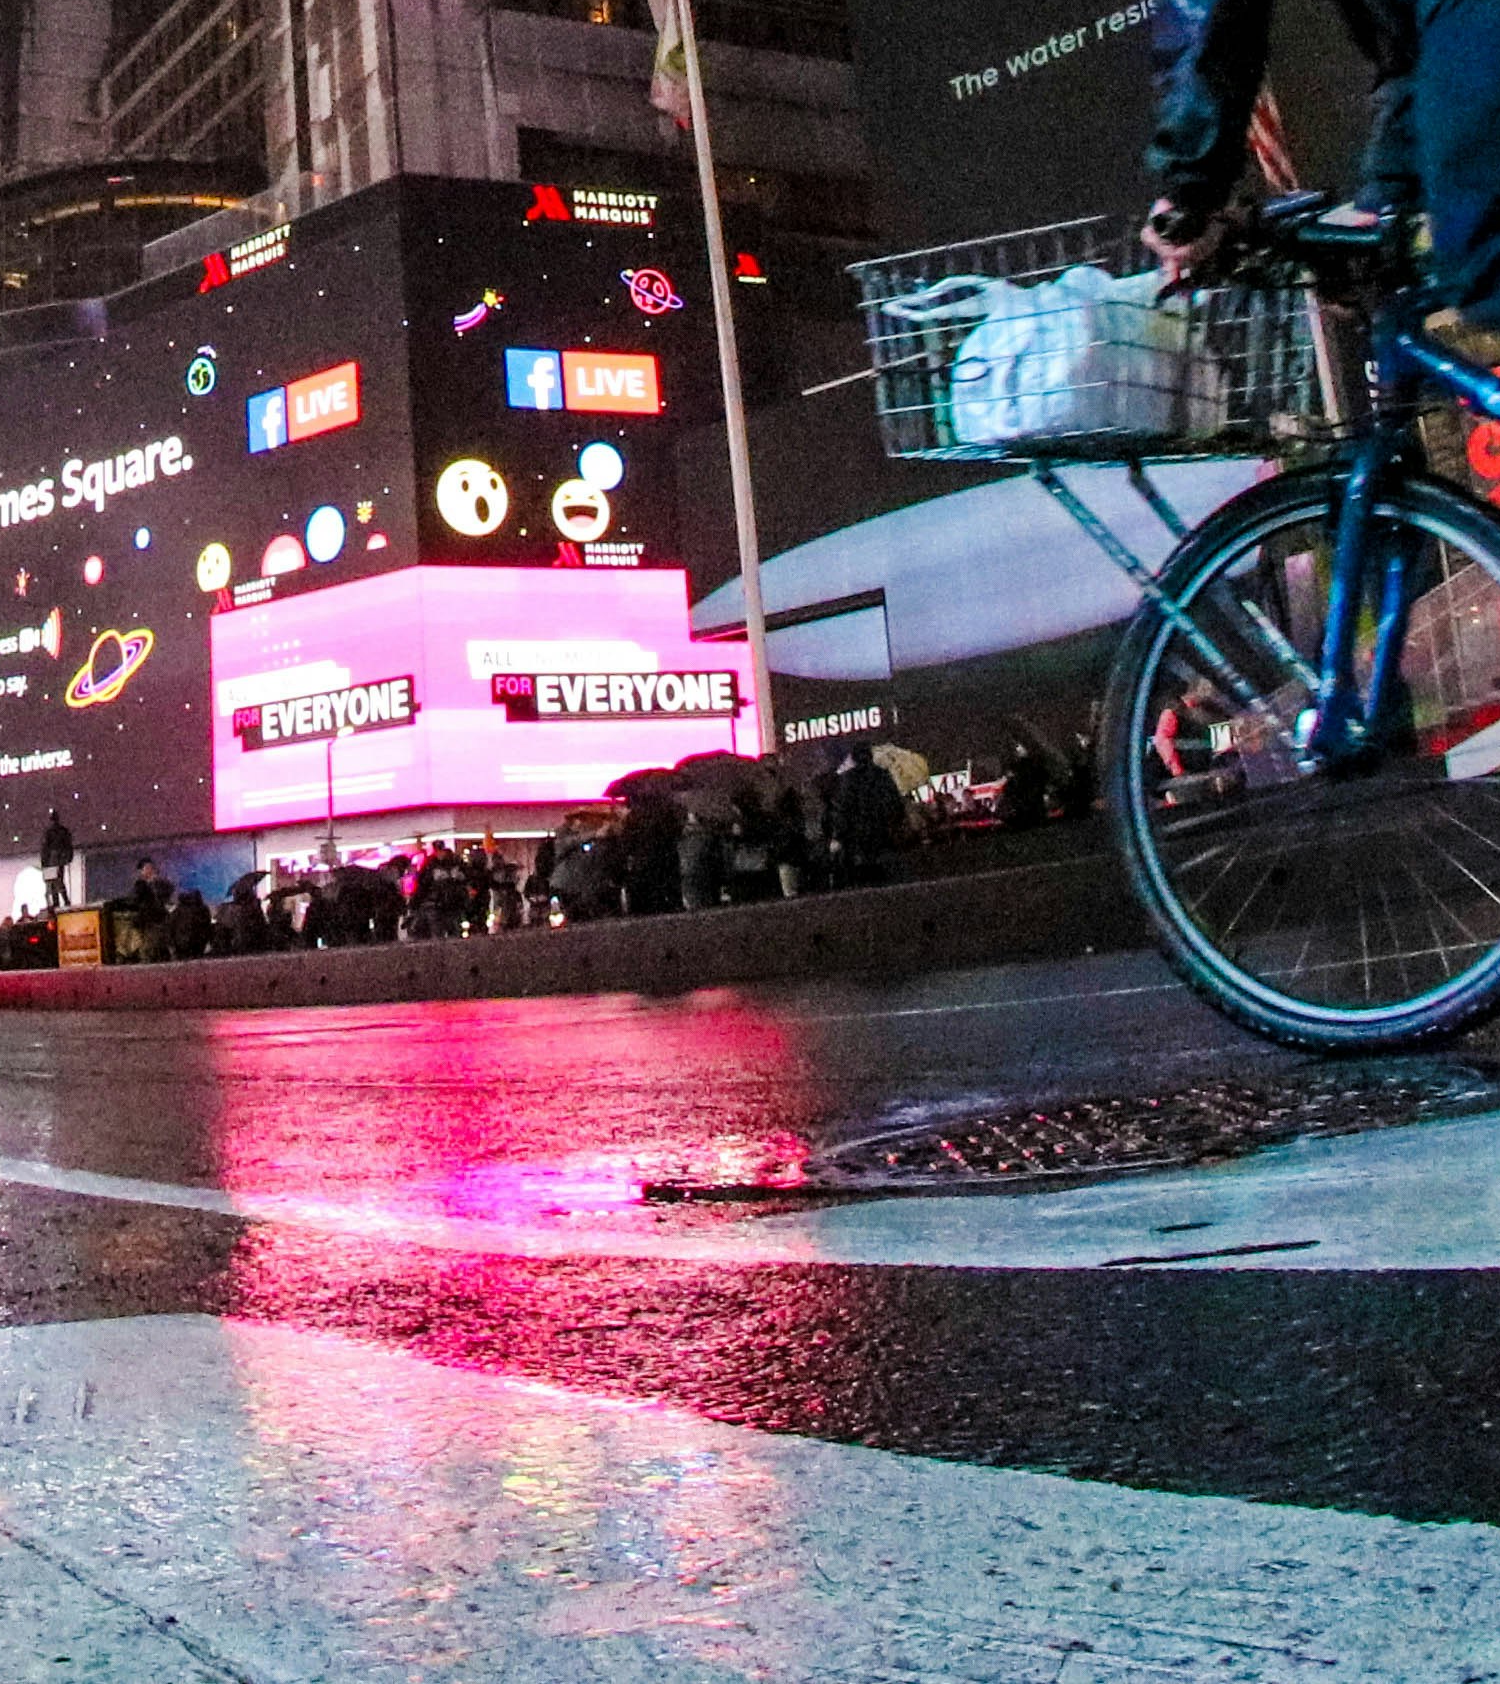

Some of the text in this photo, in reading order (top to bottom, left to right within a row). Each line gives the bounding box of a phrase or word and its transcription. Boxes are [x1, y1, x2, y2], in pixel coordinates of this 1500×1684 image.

[949, 67, 999, 101] The
[1006, 26, 1088, 78] water
[573, 190, 658, 210] MARRIOTT
[574, 206, 651, 225] MARQUIS
[230, 224, 291, 260] MARRIOTT
[231, 242, 287, 277] MARQUIS
[575, 367, 646, 400] LIVE
[296, 381, 348, 425] LIVE
[61, 435, 193, 512] Square.
[584, 543, 644, 557] MARRIOTT
[585, 554, 639, 567] MARQUIS
[6, 674, 28, 698] say.
[495, 673, 733, 713] FOR EVERYONE
[234, 707, 260, 731] FOR
[261, 680, 412, 741] EVERYONE
[784, 706, 881, 744] SAMSUNG
[0, 753, 20, 774] the
[20, 747, 74, 772] universe.
